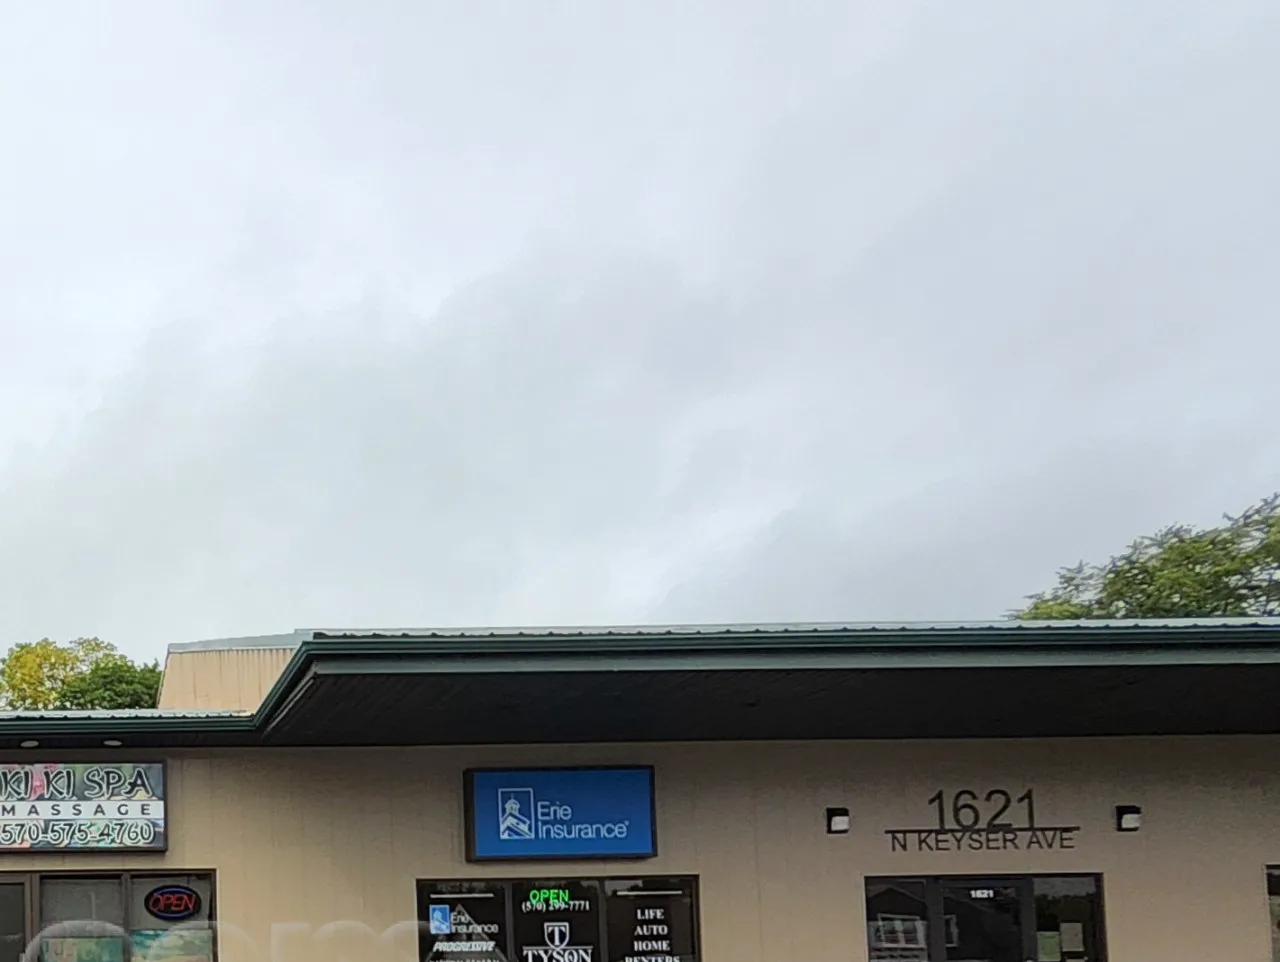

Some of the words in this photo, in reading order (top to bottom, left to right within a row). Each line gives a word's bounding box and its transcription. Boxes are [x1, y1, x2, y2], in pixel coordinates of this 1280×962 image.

[1, 768, 33, 799] KI
[43, 767, 75, 799] KI
[83, 767, 153, 799] SPA
[1, 803, 151, 816] MASSAGE
[537, 801, 572, 820] Erie
[928, 788, 1035, 830] 1621
[0, 823, 155, 844] 570-575-4760
[891, 832, 907, 851] N
[918, 831, 1020, 850] KEYSER
[1027, 830, 1075, 849] AVE
[148, 894, 196, 911] OPEN
[529, 889, 570, 904] OPEN
[637, 909, 664, 920] LIFE
[634, 925, 668, 935] AUTO
[634, 941, 670, 952] HOME
